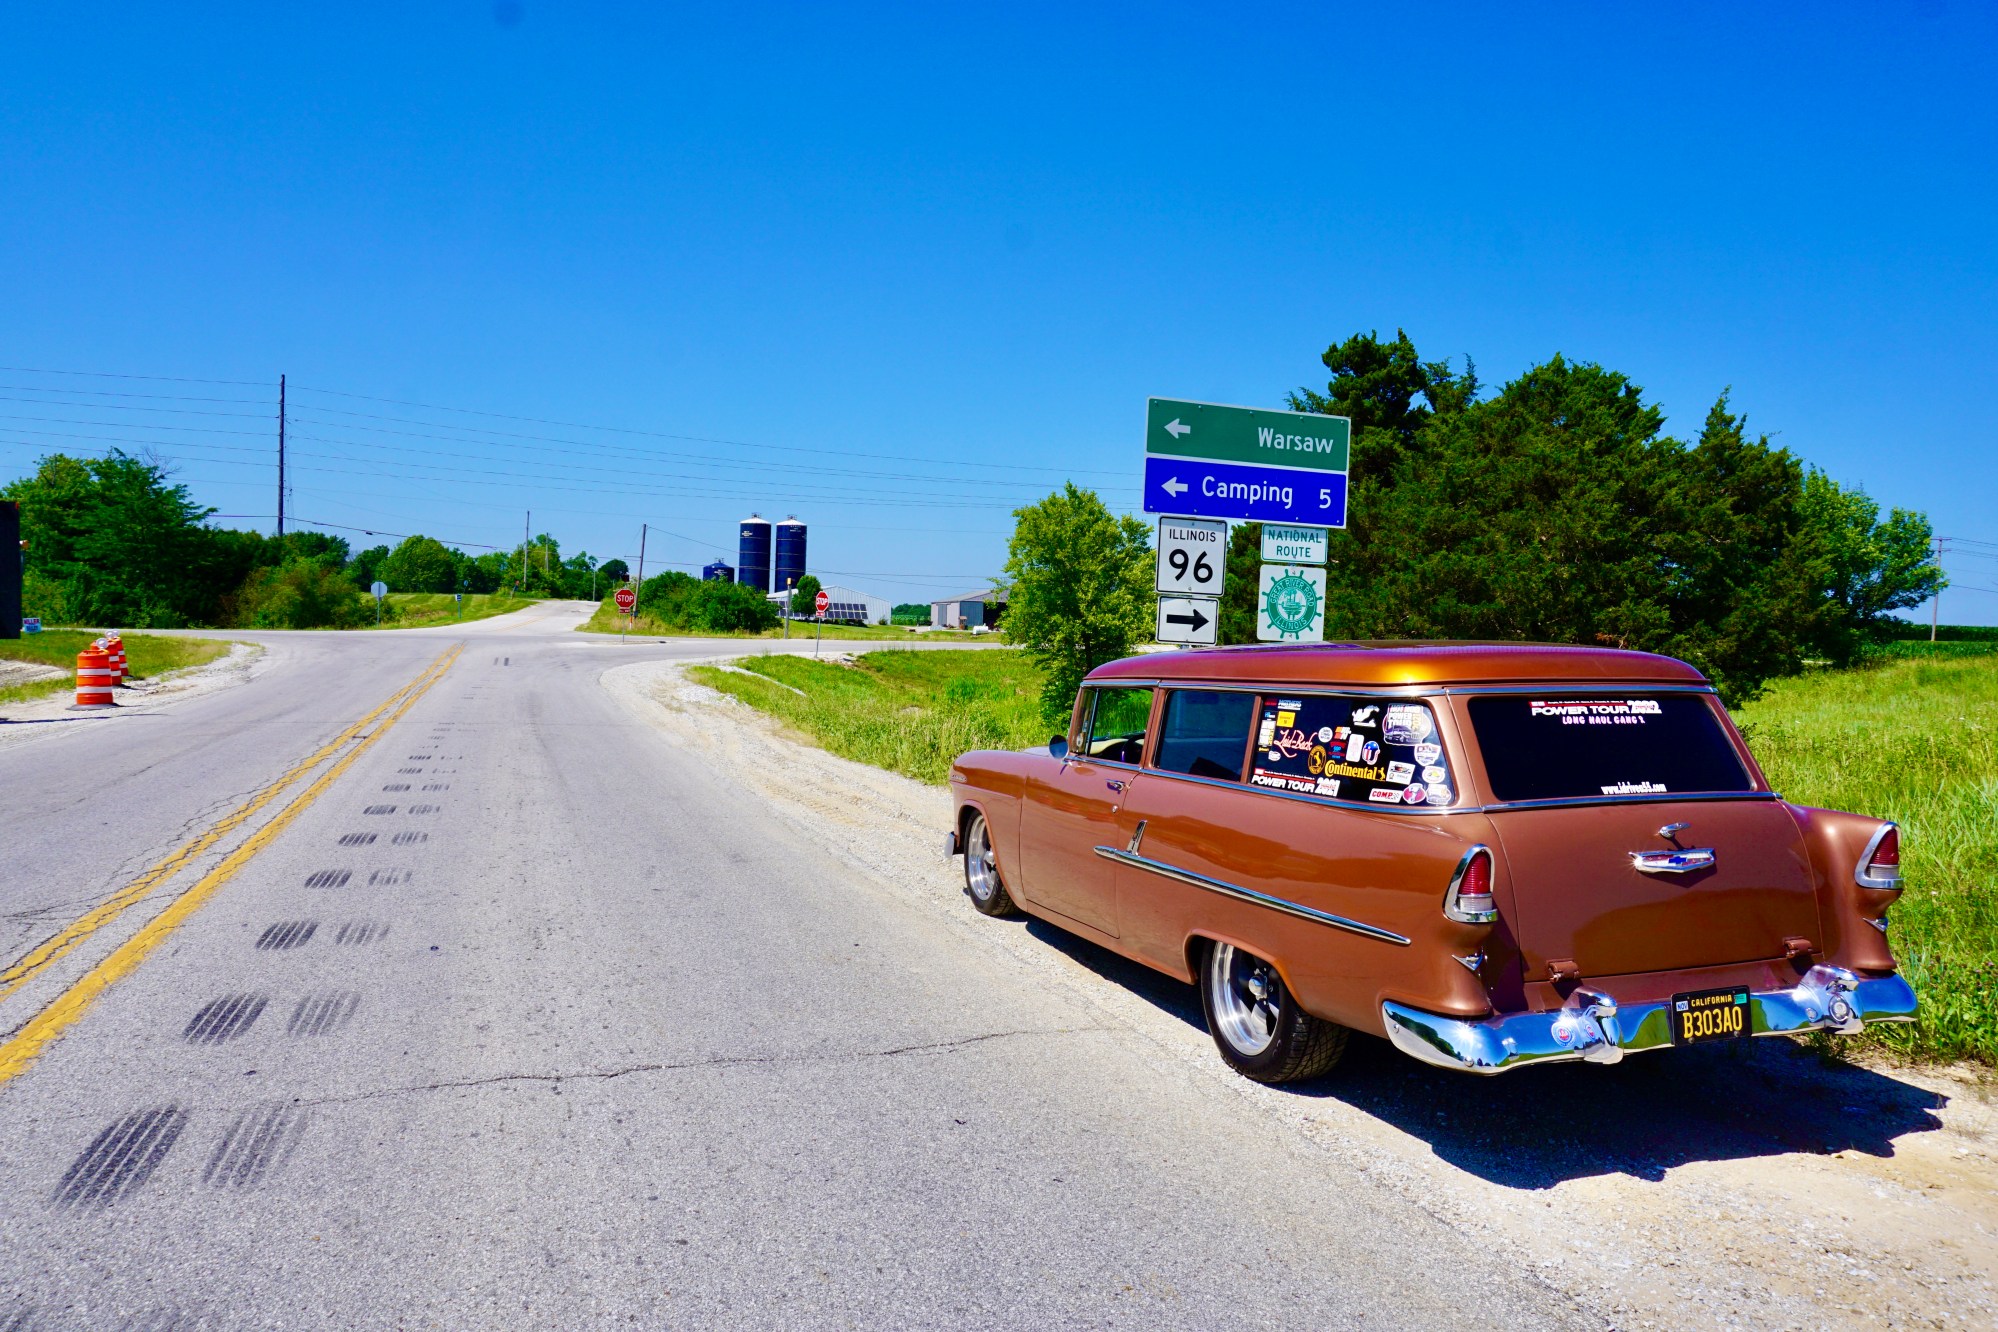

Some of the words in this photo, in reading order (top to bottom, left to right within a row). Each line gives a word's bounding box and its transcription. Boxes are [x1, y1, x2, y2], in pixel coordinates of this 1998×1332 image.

[1257, 426, 1334, 454] Warsaw
[1201, 475, 1293, 509] Camping
[1318, 488, 1332, 509] 5
[1168, 528, 1217, 543] ILLINOIS
[1267, 529, 1322, 544] NATIONAL
[1276, 545, 1312, 558] ROUTE
[1168, 548, 1214, 584] 96
[617, 594, 634, 603] STOP
[1270, 580, 1286, 604] GREAT
[1285, 579, 1305, 590] RIVER
[1303, 586, 1315, 607] ROAD
[816, 597, 829, 606] STOP
[1274, 615, 1308, 630] ILLINOIS
[1531, 705, 1589, 716] POWER
[1589, 705, 1630, 715] TOUR
[1562, 715, 1585, 725] LONG
[1588, 715, 1612, 725] HAUL
[1613, 715, 1638, 725] GANG
[1324, 760, 1378, 780] Continental
[1251, 775, 1287, 789] POWER
[1287, 780, 1315, 793] TOUR
[1315, 777, 1341, 797] 2021
[1677, 1002, 1687, 1010] NOV
[1691, 994, 1733, 1007] CALIFORNIA
